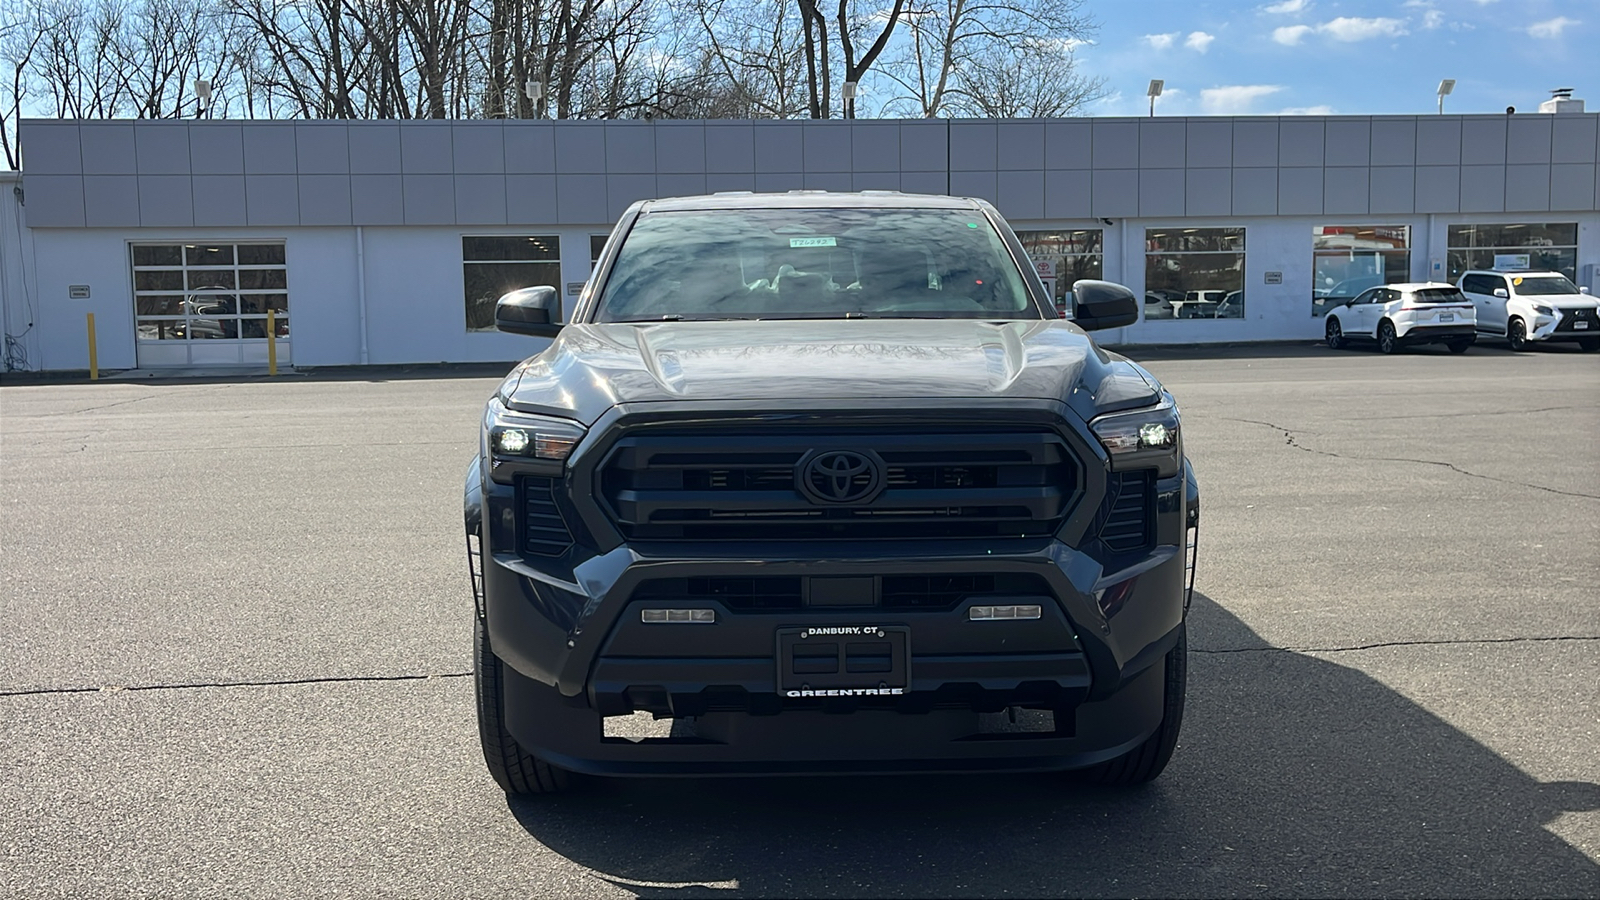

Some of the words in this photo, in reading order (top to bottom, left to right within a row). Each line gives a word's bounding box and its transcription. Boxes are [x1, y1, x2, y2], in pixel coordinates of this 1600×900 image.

[808, 627, 861, 635] DANBURY,
[863, 626, 878, 634] CT
[786, 688, 903, 698] GREENTREE
